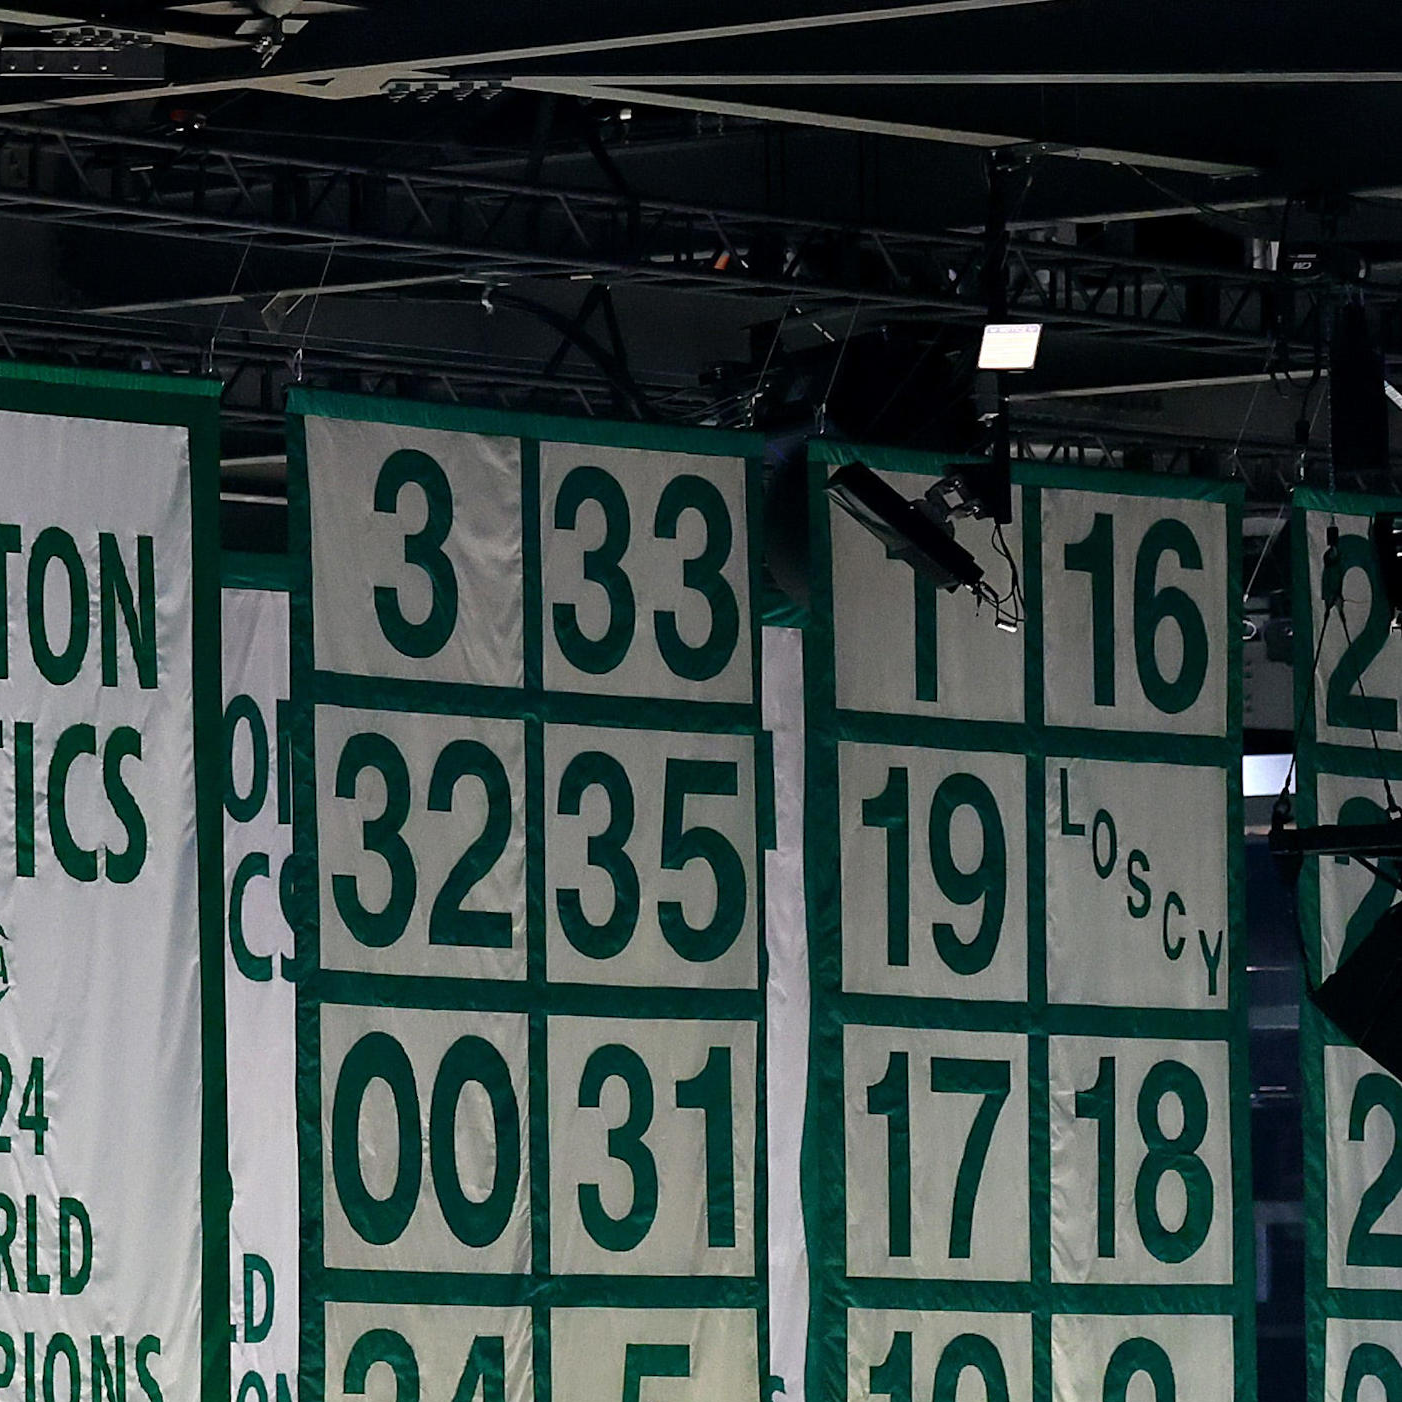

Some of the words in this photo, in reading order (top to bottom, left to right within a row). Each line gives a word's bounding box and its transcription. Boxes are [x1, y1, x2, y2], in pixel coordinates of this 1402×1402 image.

[374, 448, 458, 658] 3
[552, 466, 740, 681] 33
[1065, 513, 1209, 714] 16
[1318, 533, 1400, 732] 2
[332, 732, 515, 949] 32
[555, 750, 748, 964] 35
[861, 766, 1008, 976] 19
[1059, 767, 1223, 997] LOSCY
[332, 1031, 521, 1248] 00
[577, 1042, 736, 1253] 31
[866, 1051, 1012, 1259] 17
[1075, 1056, 1215, 1265] 18
[1346, 1072, 1402, 1266] 2
